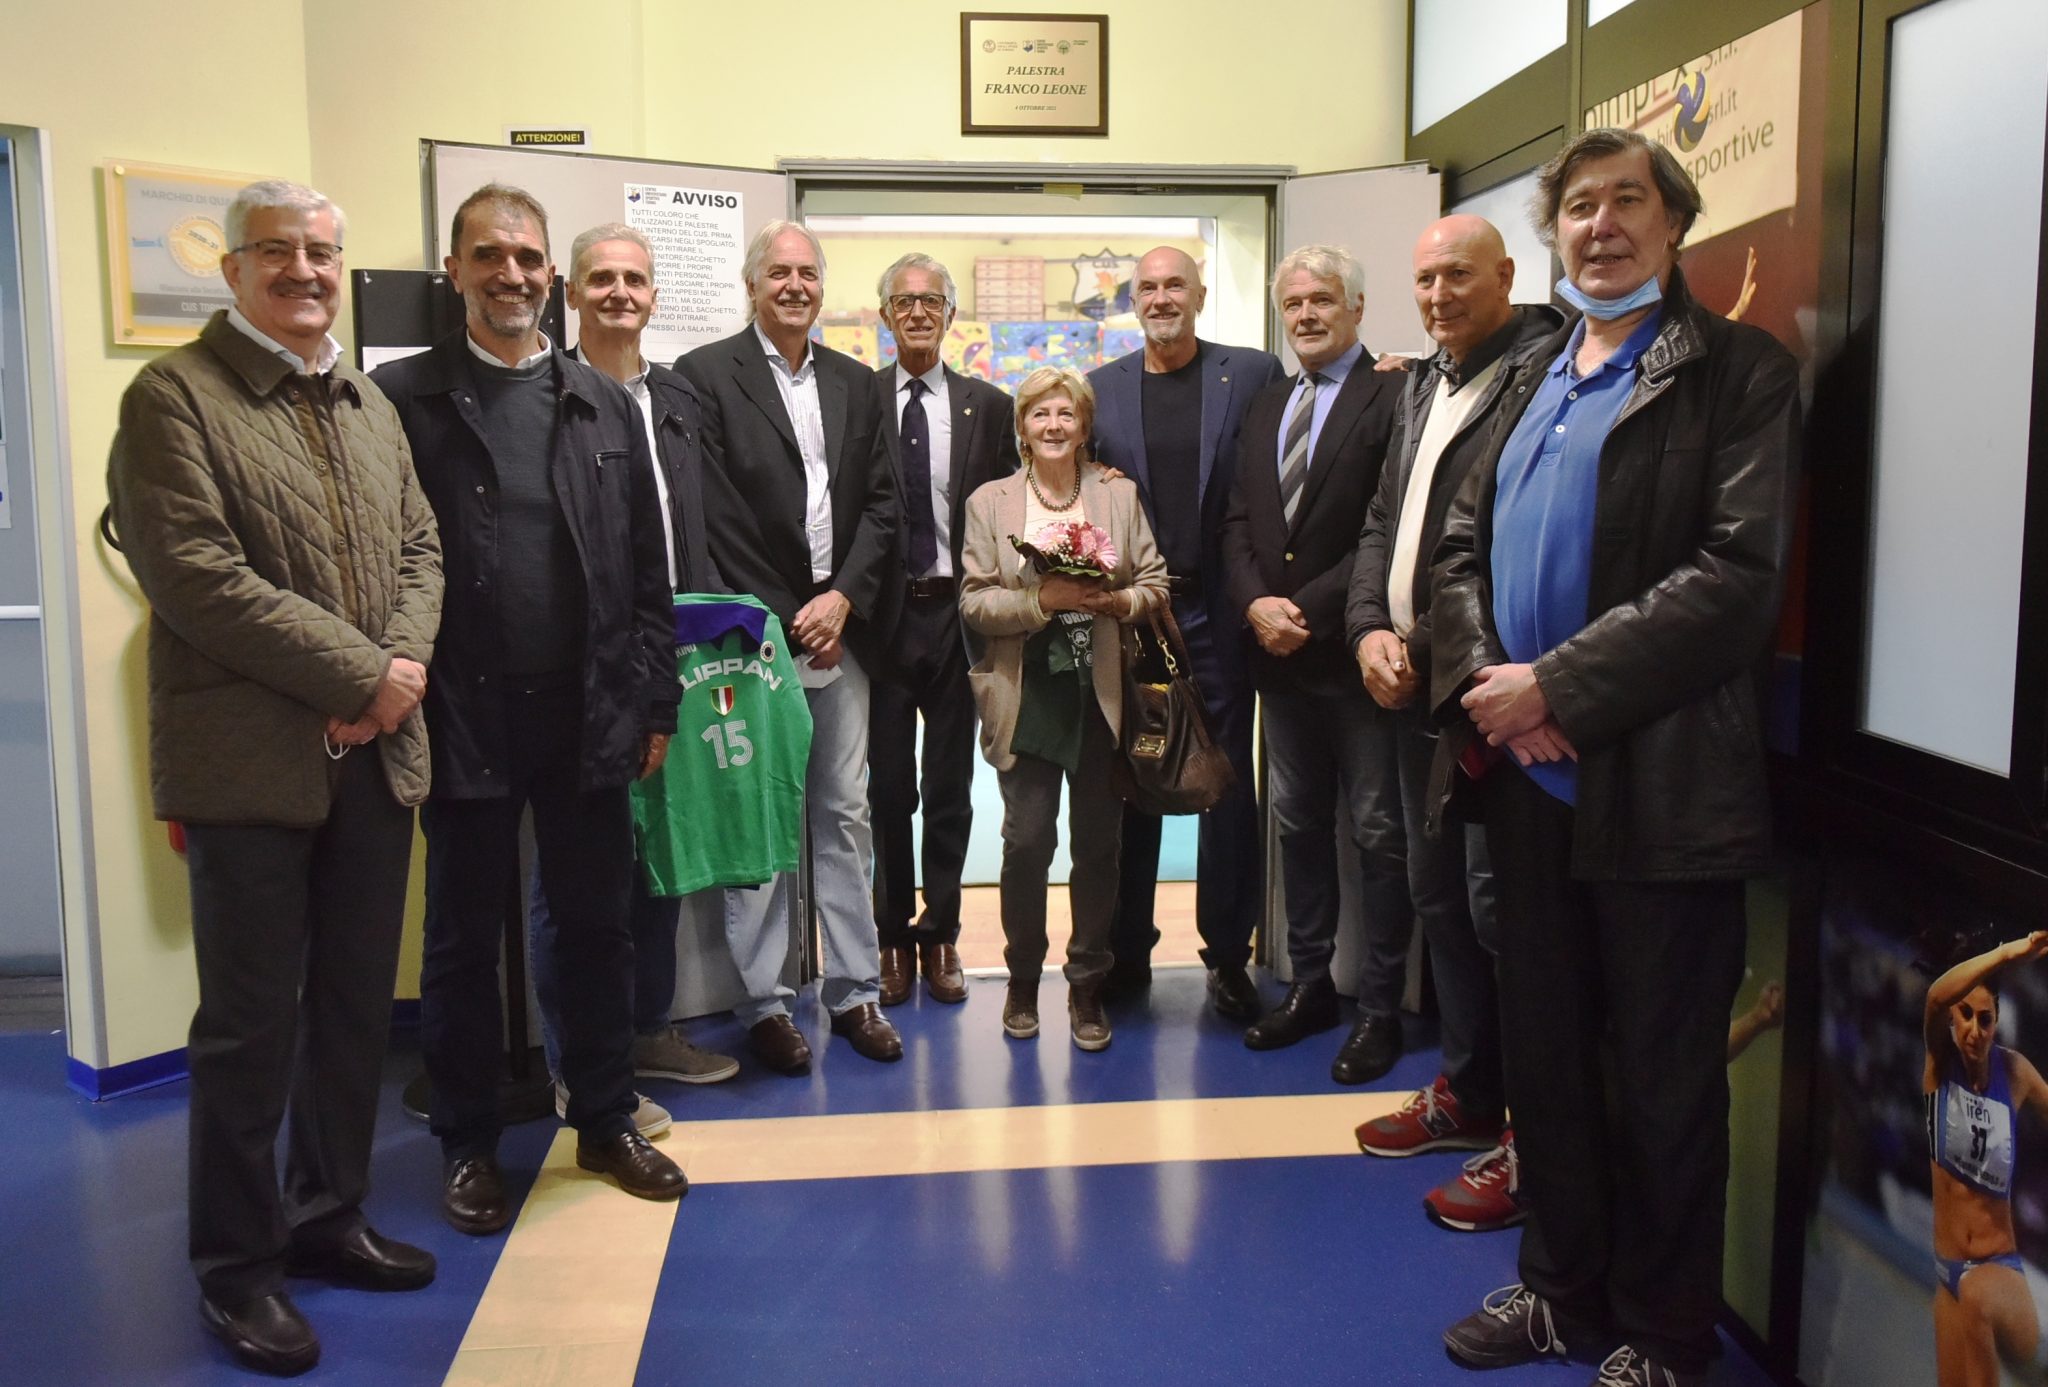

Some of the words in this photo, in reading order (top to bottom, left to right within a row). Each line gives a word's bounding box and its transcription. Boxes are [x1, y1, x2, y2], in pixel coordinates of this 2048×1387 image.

[1006, 66, 1065, 76] PALESTRA
[984, 83, 1040, 95] FRANCO
[1042, 84, 1087, 95] LEONE
[515, 133, 580, 143] ATTENZIONE!
[1686, 121, 1774, 188] sportive
[141, 189, 193, 203] MARCHIO
[672, 191, 737, 209] AVVISO
[632, 209, 651, 217] TUTTI
[653, 210, 683, 219] COLORO
[685, 212, 699, 220] CHE
[632, 217, 673, 227] UTILIZZANO
[685, 221, 719, 230] PALESTRE
[679, 229, 692, 237] DEL
[674, 237, 695, 245] NEGLI
[665, 246, 696, 254] RITIRARE
[687, 263, 713, 271] PROPRI
[671, 280, 704, 288] LASCIARE
[675, 288, 699, 296] APPESI
[681, 305, 694, 313] DEL
[696, 306, 737, 315] SACCHETTO
[646, 324, 675, 332] PRESSO
[687, 325, 704, 333] SALA
[678, 658, 783, 691] LIPPAN
[700, 719, 754, 769] 15
[1966, 1098, 1991, 1124] iren
[1970, 1124, 1987, 1162] 37
